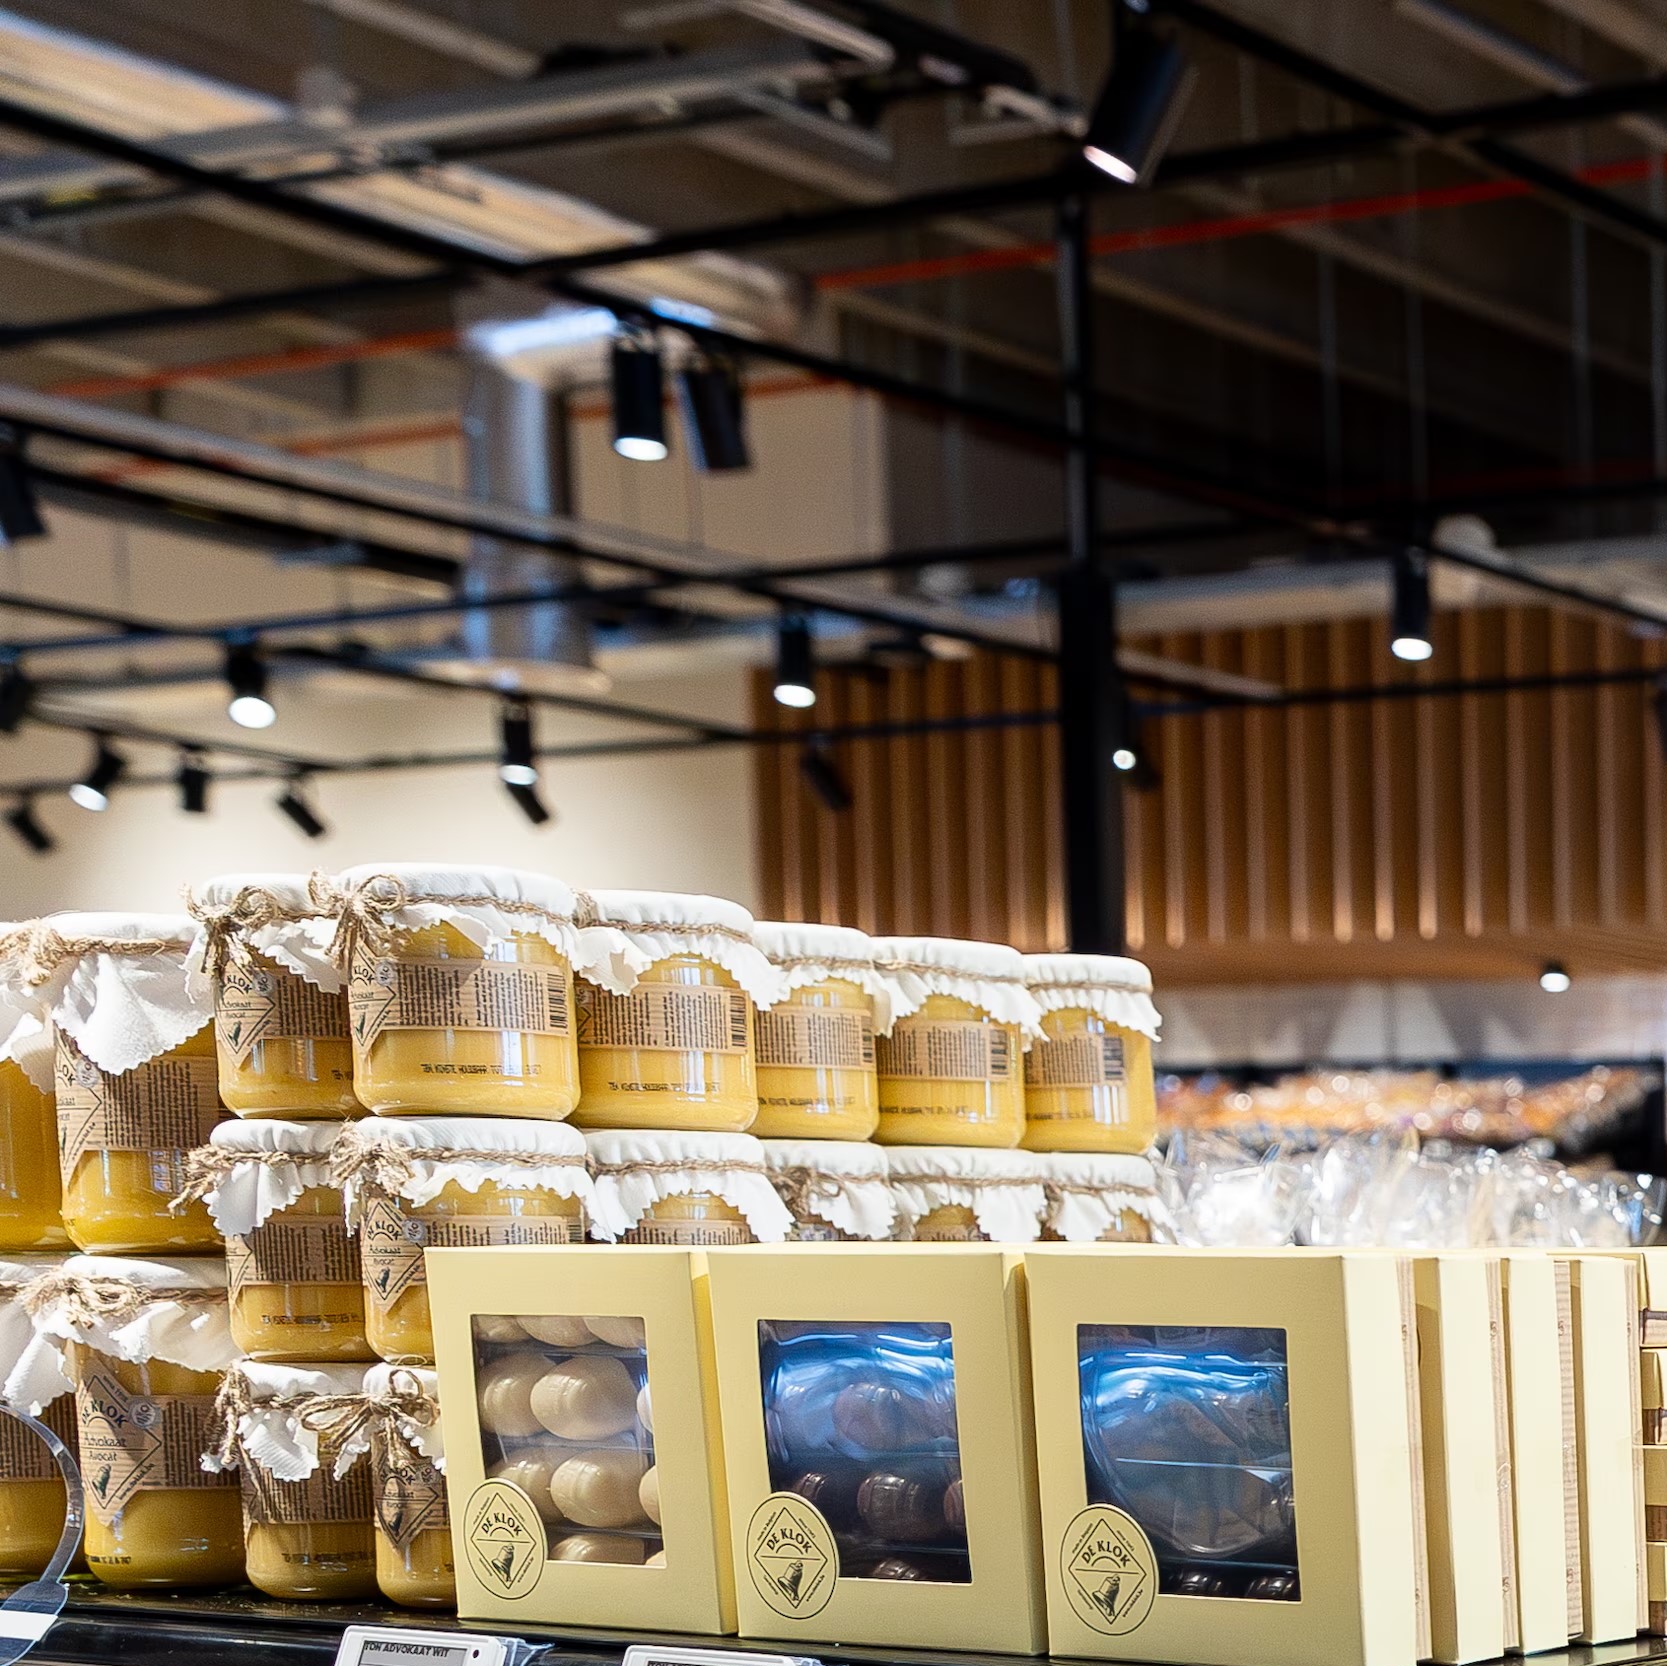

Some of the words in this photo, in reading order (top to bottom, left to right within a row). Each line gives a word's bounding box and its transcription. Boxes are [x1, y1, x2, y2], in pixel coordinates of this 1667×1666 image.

[91, 1400, 129, 1429] KLOK
[481, 1517, 494, 1534] DE
[494, 1512, 522, 1537] KLOK
[766, 1533, 780, 1551] DE
[780, 1528, 812, 1553] KLOK
[1081, 1545, 1096, 1564] DE
[1097, 1540, 1131, 1567] KLOK
[364, 1641, 381, 1652] TON
[383, 1644, 430, 1657] ADVOKAAT
[432, 1648, 449, 1658] WIT
